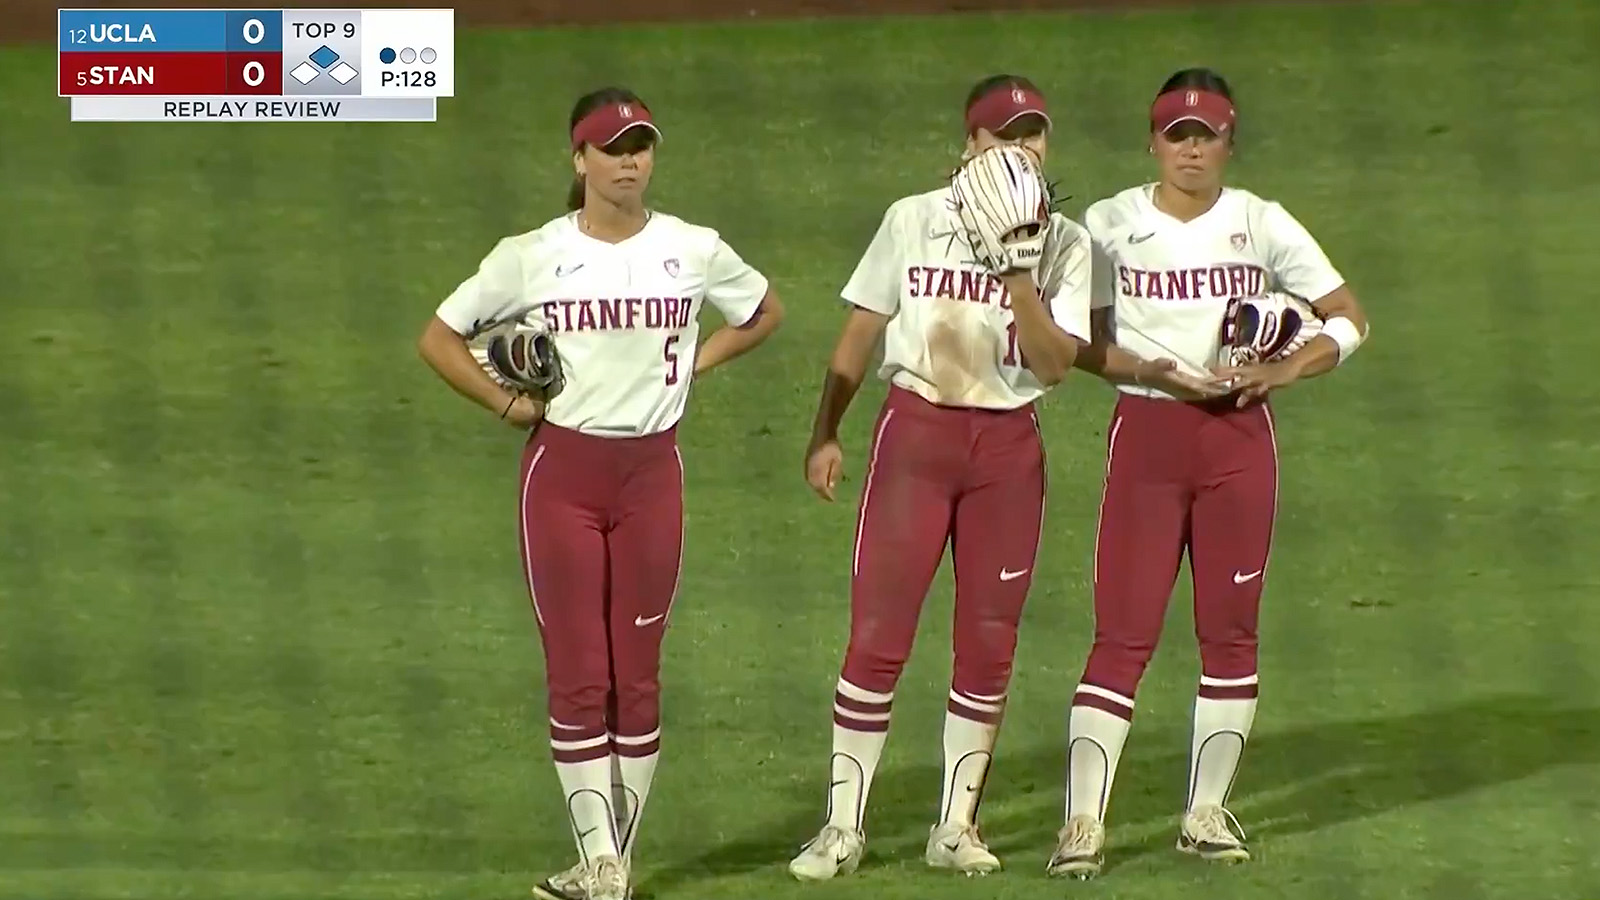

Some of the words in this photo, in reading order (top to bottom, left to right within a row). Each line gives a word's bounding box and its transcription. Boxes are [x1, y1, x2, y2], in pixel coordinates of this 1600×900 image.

[1120, 265, 1264, 300] STANFORD
[543, 297, 691, 333] STANFORD
[664, 335, 679, 386] 5
